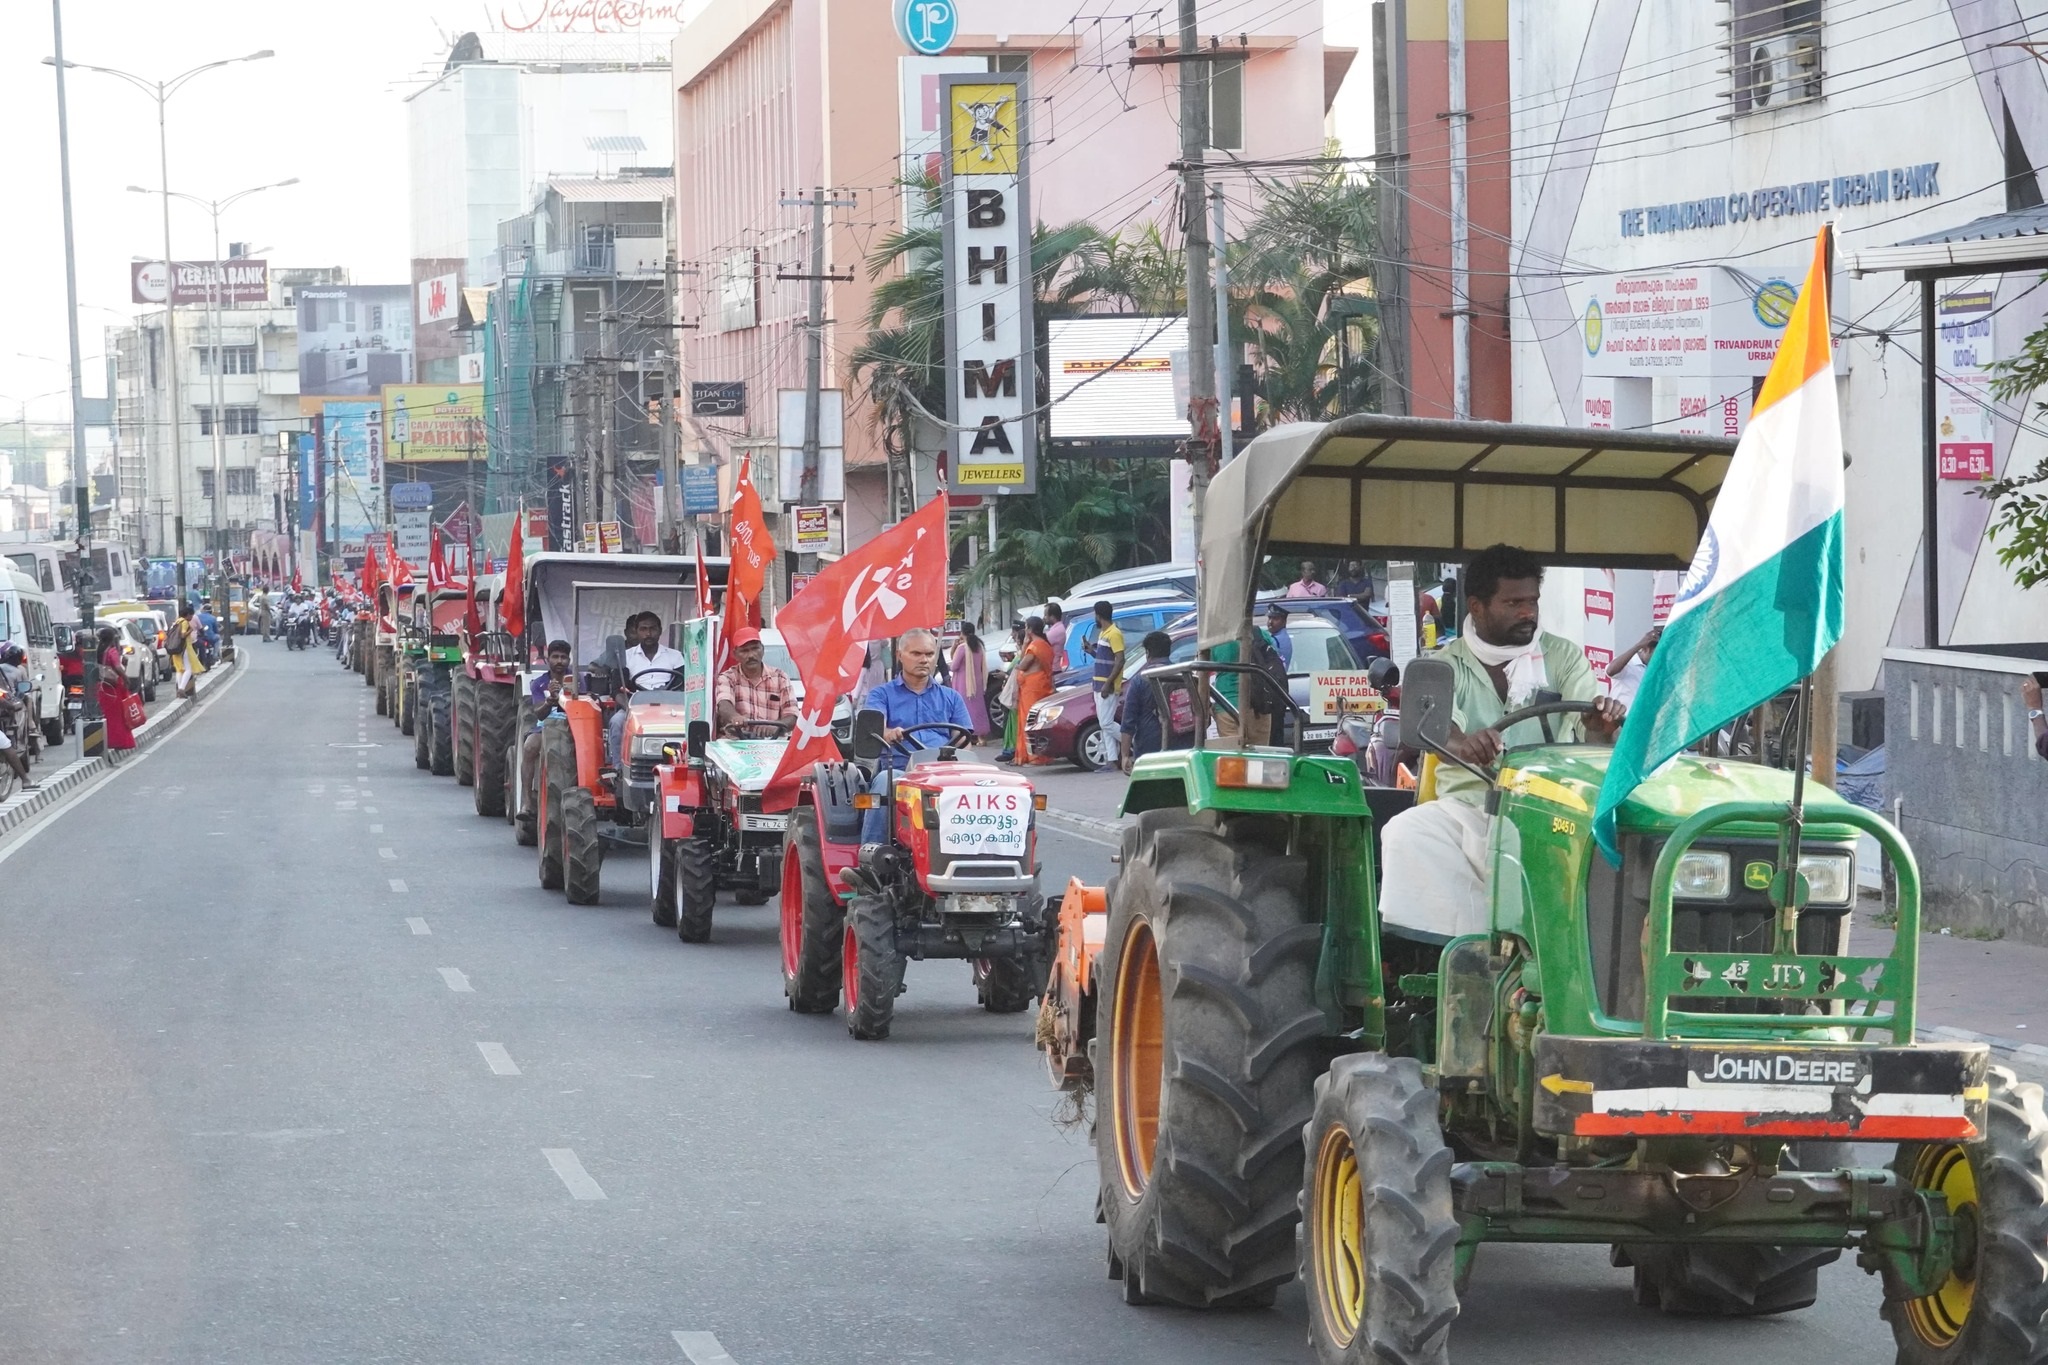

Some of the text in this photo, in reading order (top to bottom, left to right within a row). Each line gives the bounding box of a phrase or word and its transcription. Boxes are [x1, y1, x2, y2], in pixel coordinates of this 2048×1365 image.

[1619, 207, 1644, 238] THE
[1645, 196, 1726, 236] TRIVANDRUM
[1832, 170, 1889, 208] URBAN
[1890, 161, 1940, 201] BANK
[178, 266, 265, 286] KERALA BANK
[302, 291, 347, 299] Panasonic
[964, 189, 1016, 456] BHIMA
[1651, 338, 1657, 351] &
[1714, 340, 1773, 350] TRIVANDRUM
[695, 390, 720, 398] TITAN
[370, 429, 381, 484] PARKING
[961, 469, 1022, 480] JEWELLERS
[1317, 677, 1347, 685] VALET
[1328, 687, 1380, 697] AVAILABLE
[957, 795, 1017, 810] AIKS
[951, 814, 1018, 830] കഴക്കൂട്ടം
[1552, 816, 1569, 833] 5045
[1704, 1054, 1857, 1082] JOHN DEERE
